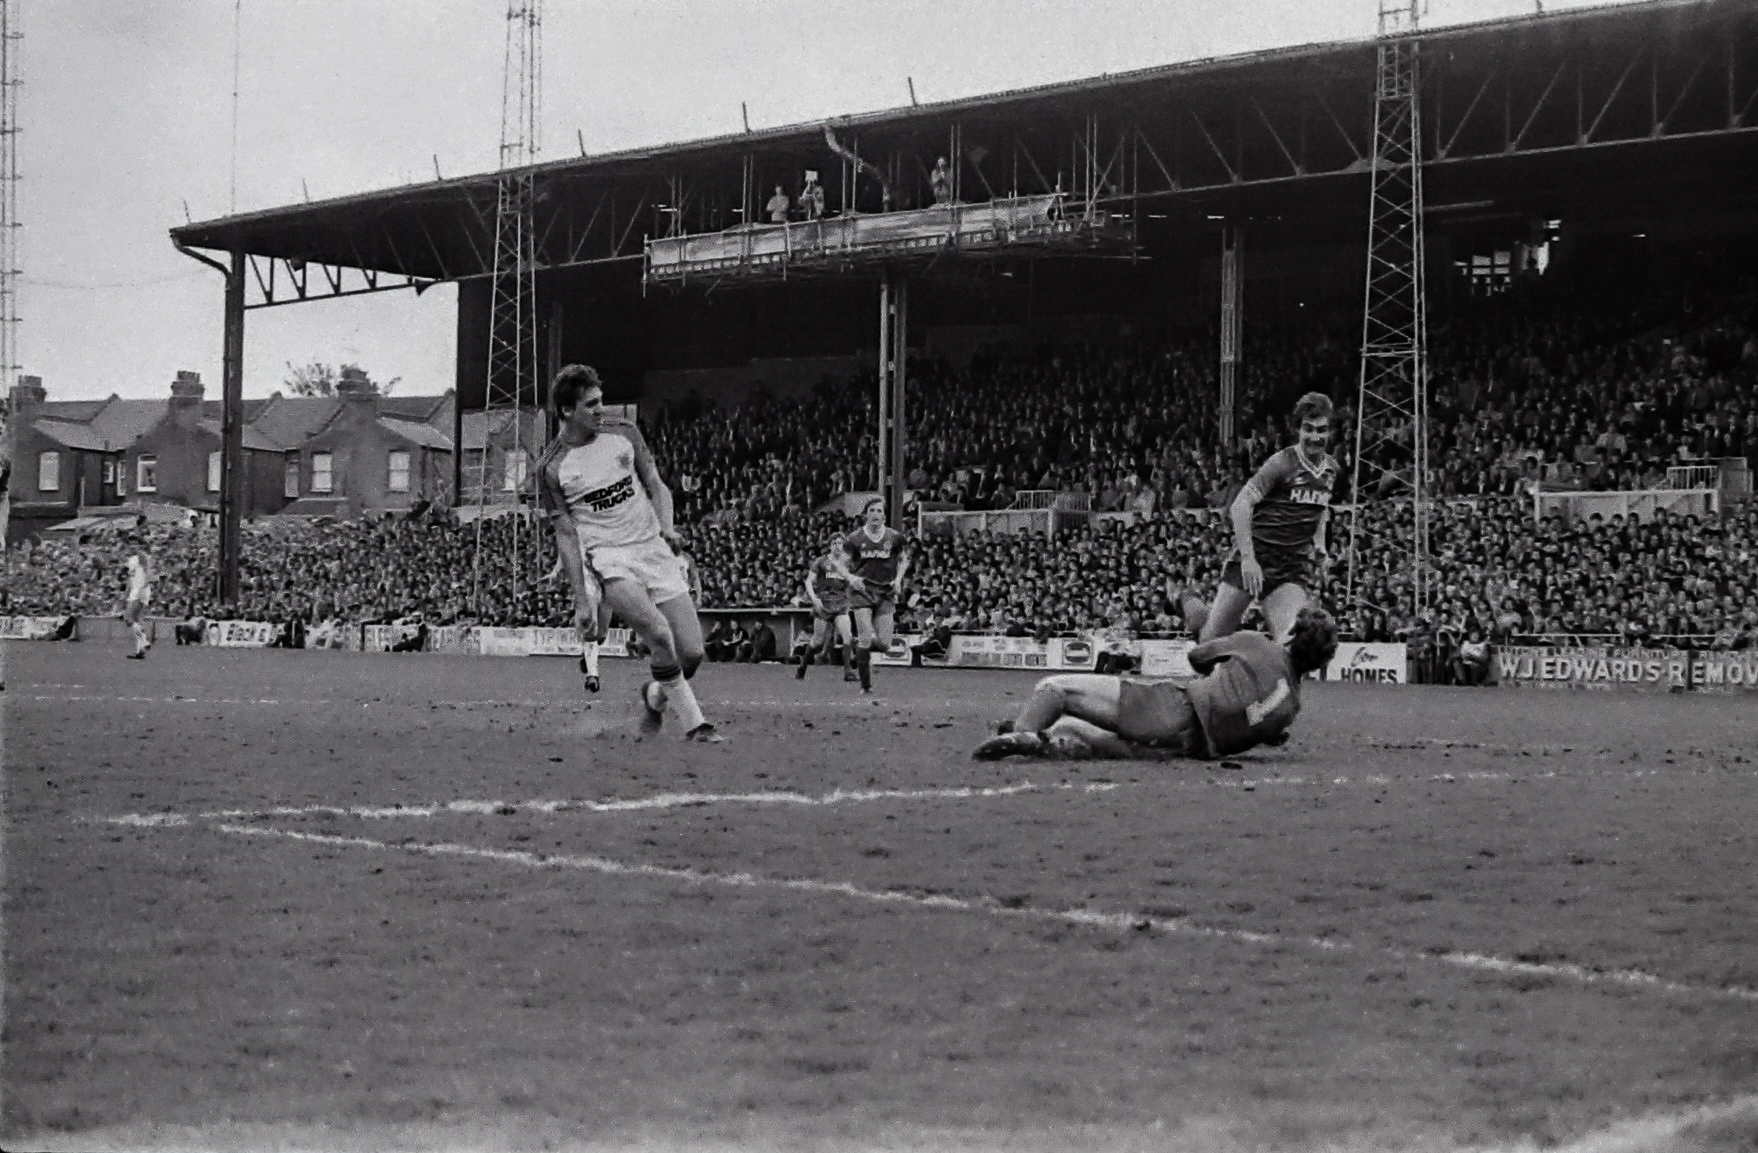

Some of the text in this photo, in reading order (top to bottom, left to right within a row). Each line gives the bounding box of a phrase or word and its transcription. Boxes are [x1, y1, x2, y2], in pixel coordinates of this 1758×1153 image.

[590, 487, 635, 512] TRUCKS
[1341, 667, 1397, 685] HOMES
[1542, 658, 1661, 682] EDWARDS
